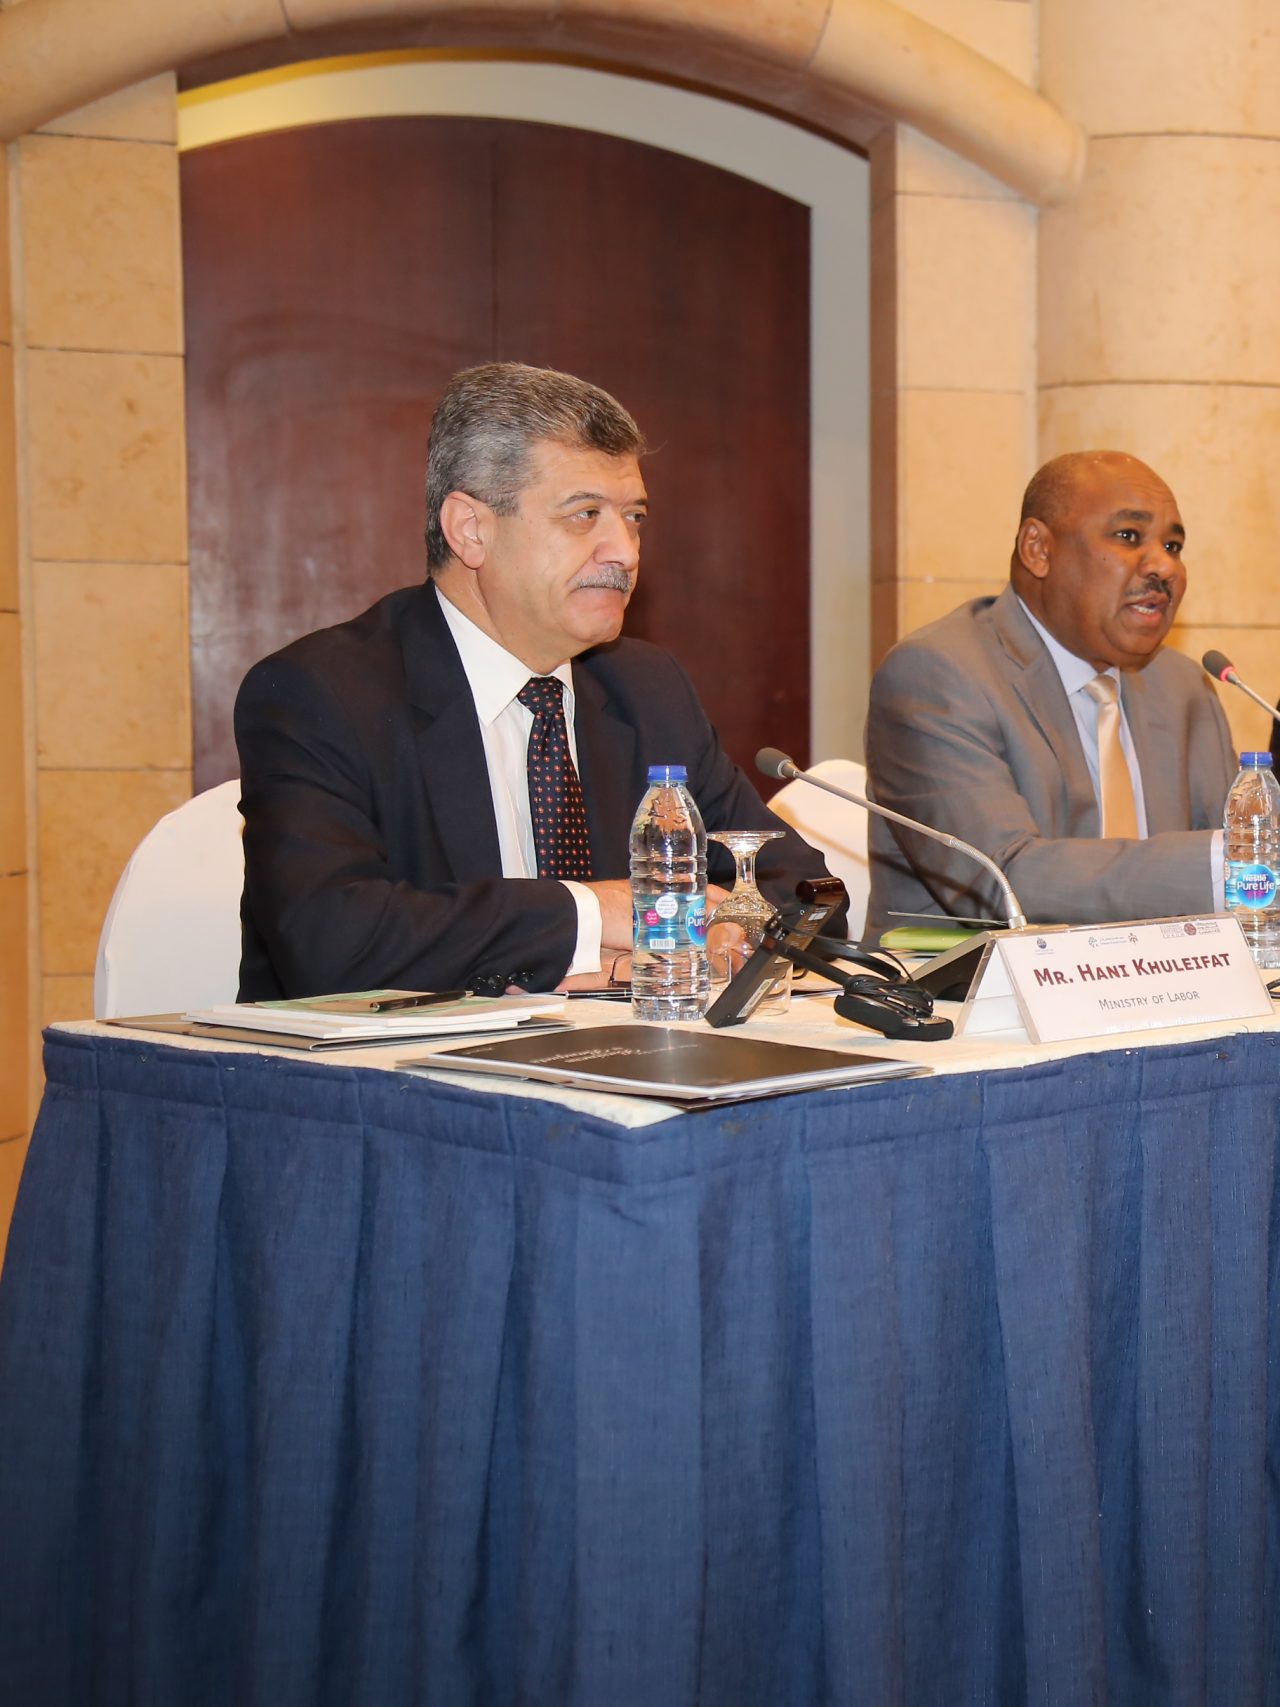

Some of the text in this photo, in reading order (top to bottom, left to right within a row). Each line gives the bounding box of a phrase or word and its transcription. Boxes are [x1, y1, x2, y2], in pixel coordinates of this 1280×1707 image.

[1237, 880, 1275, 894] Pure Life
[1033, 953, 1231, 987] MR. HANI KHULEIFAT
[1098, 990, 1201, 1011] MINISTRY OF LABOR
